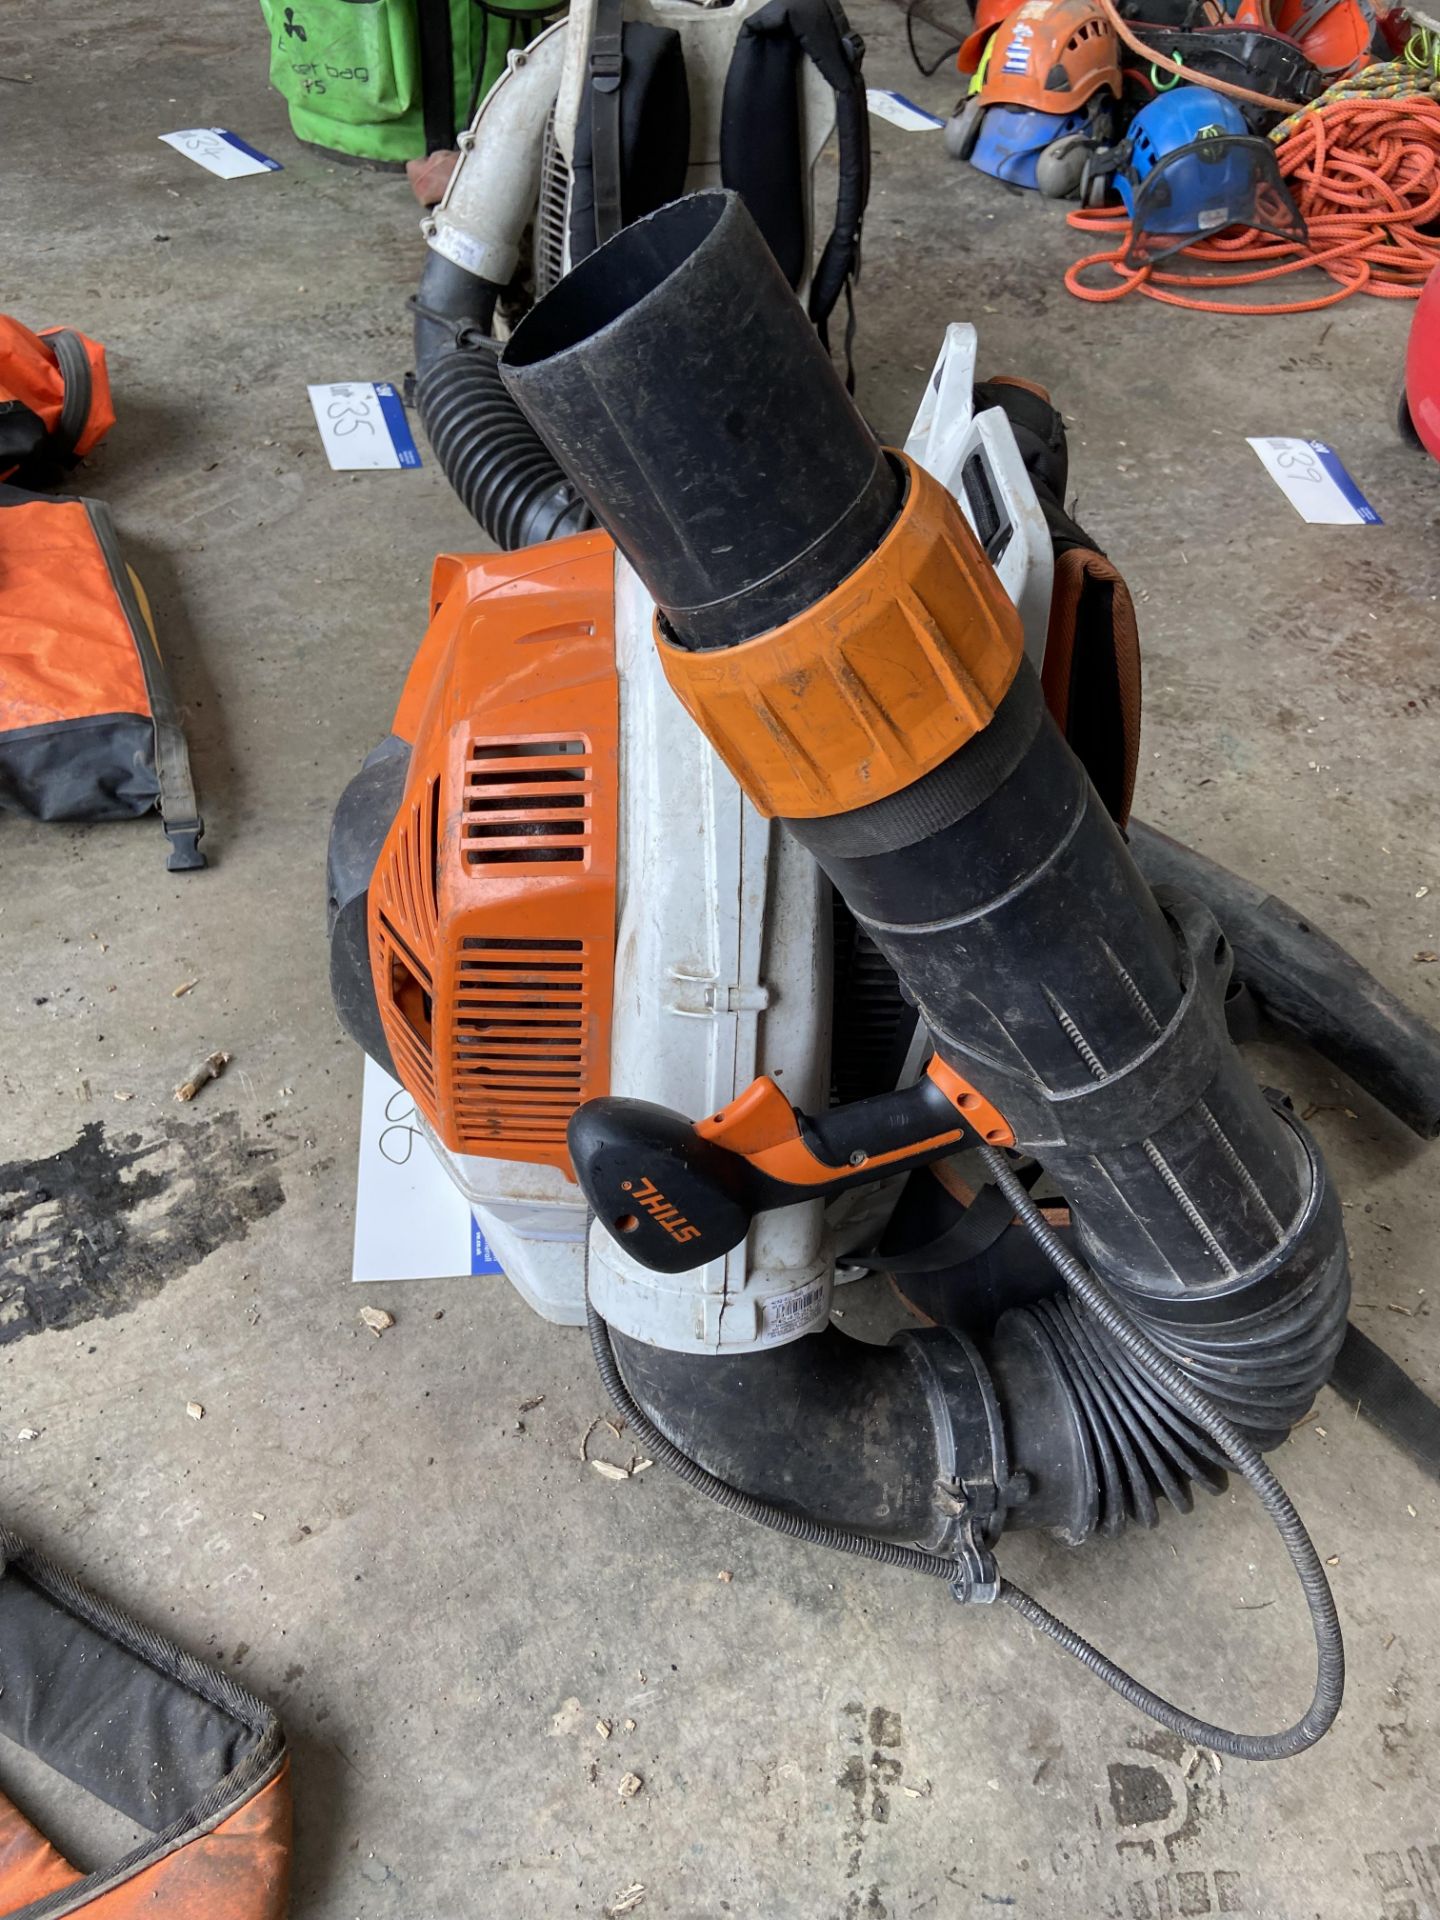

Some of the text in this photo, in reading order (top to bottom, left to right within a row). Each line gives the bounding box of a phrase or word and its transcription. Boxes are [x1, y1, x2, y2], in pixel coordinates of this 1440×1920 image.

[325, 64, 369, 83] bag
[185, 136, 225, 160] 34
[327, 401, 376, 437] 35
[1276, 450, 1323, 484] 39
[631, 1177, 702, 1244] STIHL
